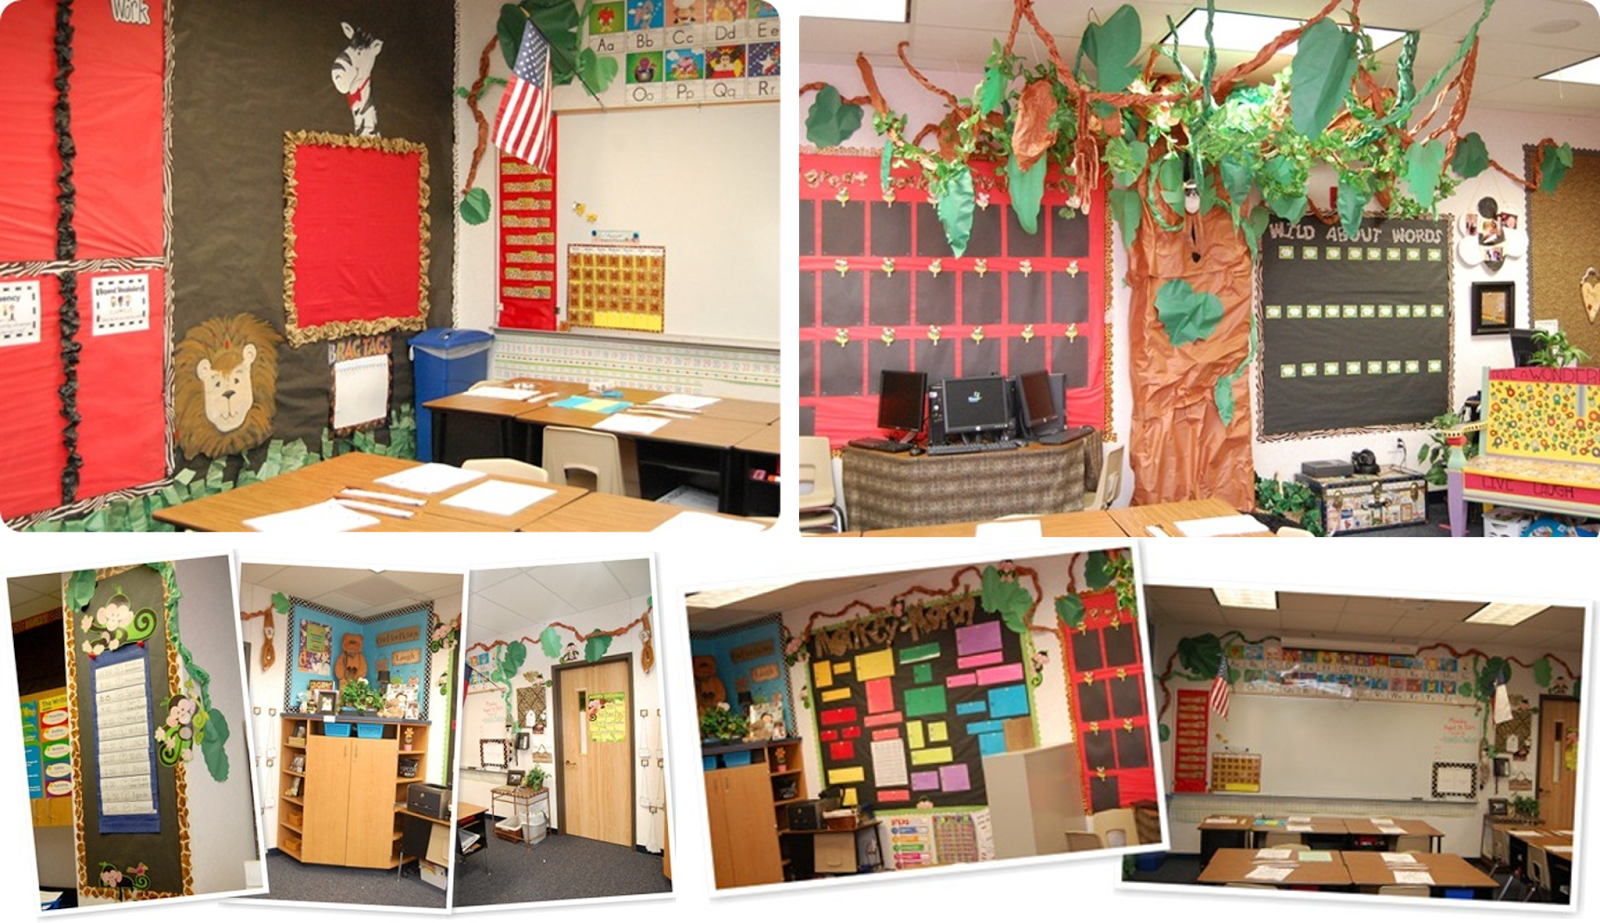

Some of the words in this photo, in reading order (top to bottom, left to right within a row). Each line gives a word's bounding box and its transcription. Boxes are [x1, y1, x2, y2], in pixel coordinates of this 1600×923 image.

[597, 38, 615, 52] Aa
[636, 34, 654, 49] Bb
[672, 29, 695, 45] Cc
[715, 25, 736, 41] Dd
[632, 86, 654, 102] Oo
[676, 84, 695, 100] Pp
[712, 82, 736, 98] Qq
[758, 80, 776, 96] Rr
[1269, 221, 1316, 240] WILD
[1391, 227, 1444, 244] WORDS
[328, 338, 361, 366] BRAG
[363, 335, 392, 357] TAGS
[1481, 475, 1515, 493] LIVE
[1532, 481, 1575, 499] LAUGH
